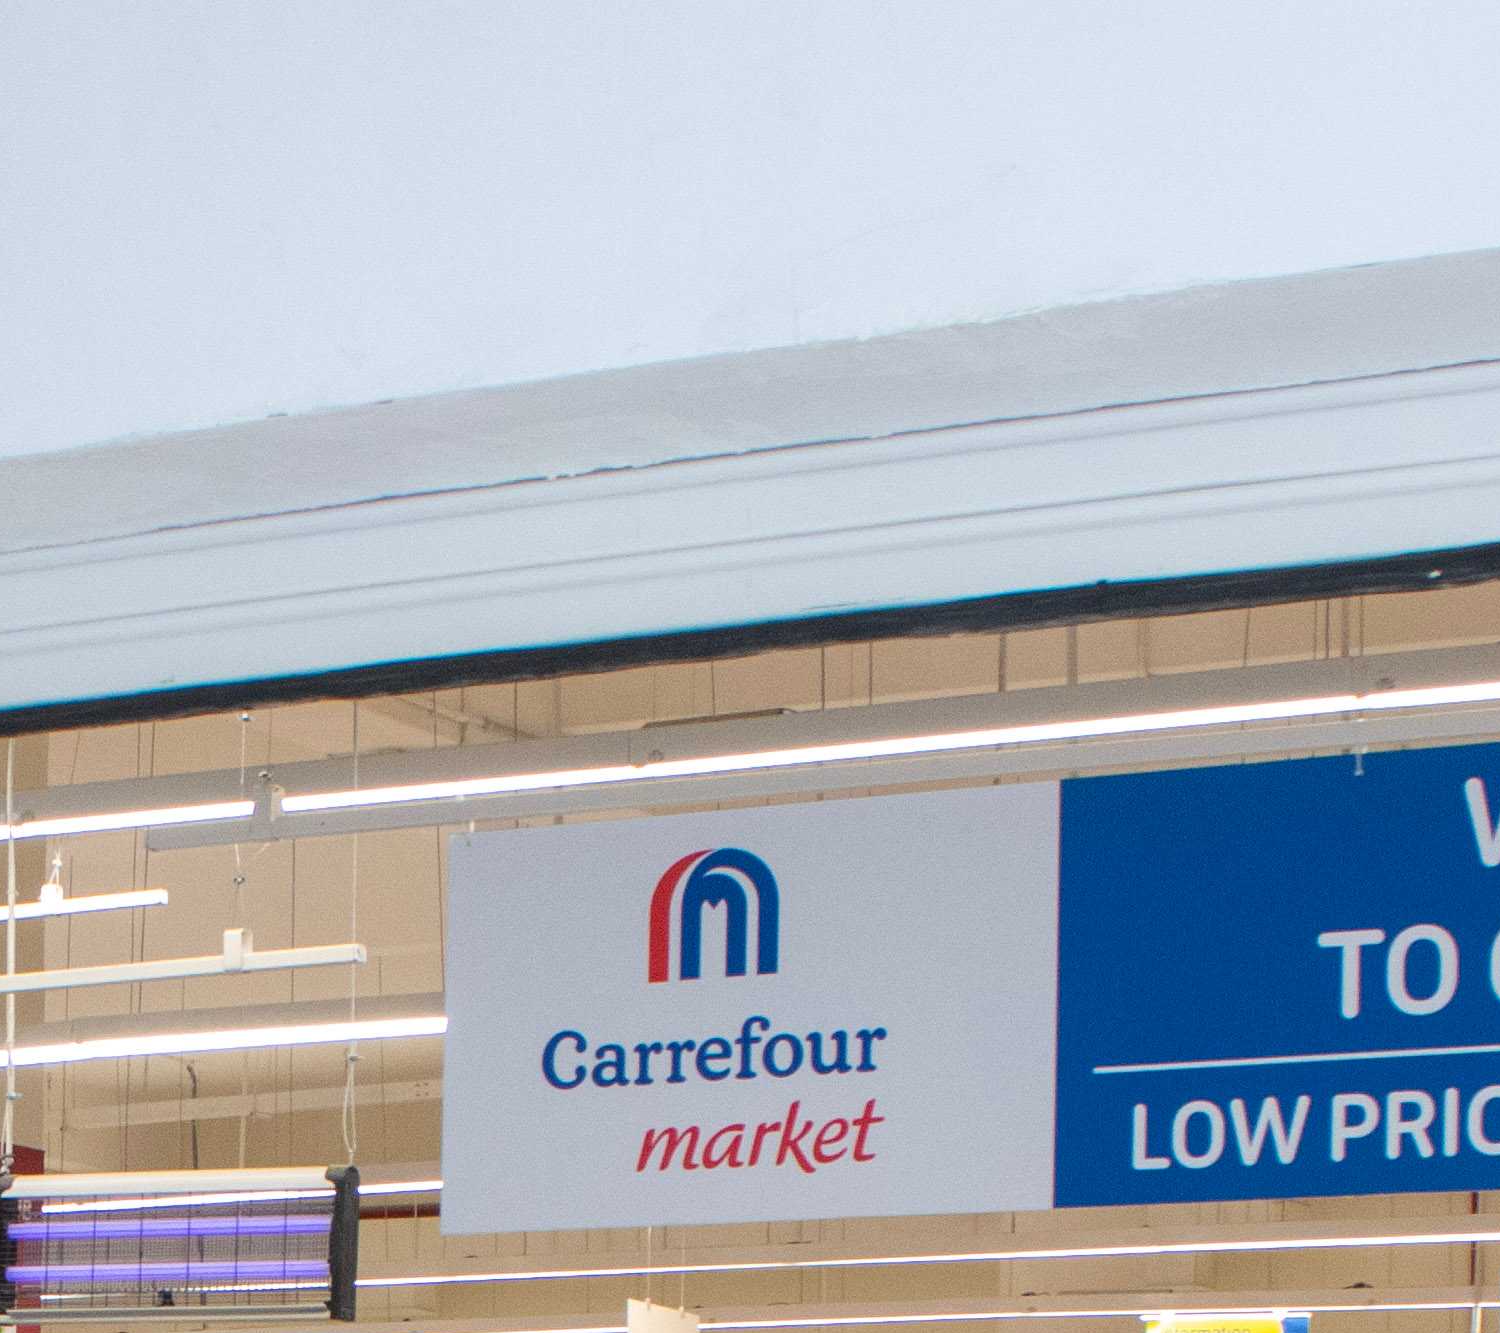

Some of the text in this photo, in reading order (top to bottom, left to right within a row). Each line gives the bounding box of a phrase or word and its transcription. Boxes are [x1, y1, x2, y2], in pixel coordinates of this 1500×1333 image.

[1318, 924, 1458, 1020] TO
[541, 1015, 887, 1090] Carrefour
[636, 1099, 885, 1174] market
[1133, 1096, 1311, 1172] LOW
